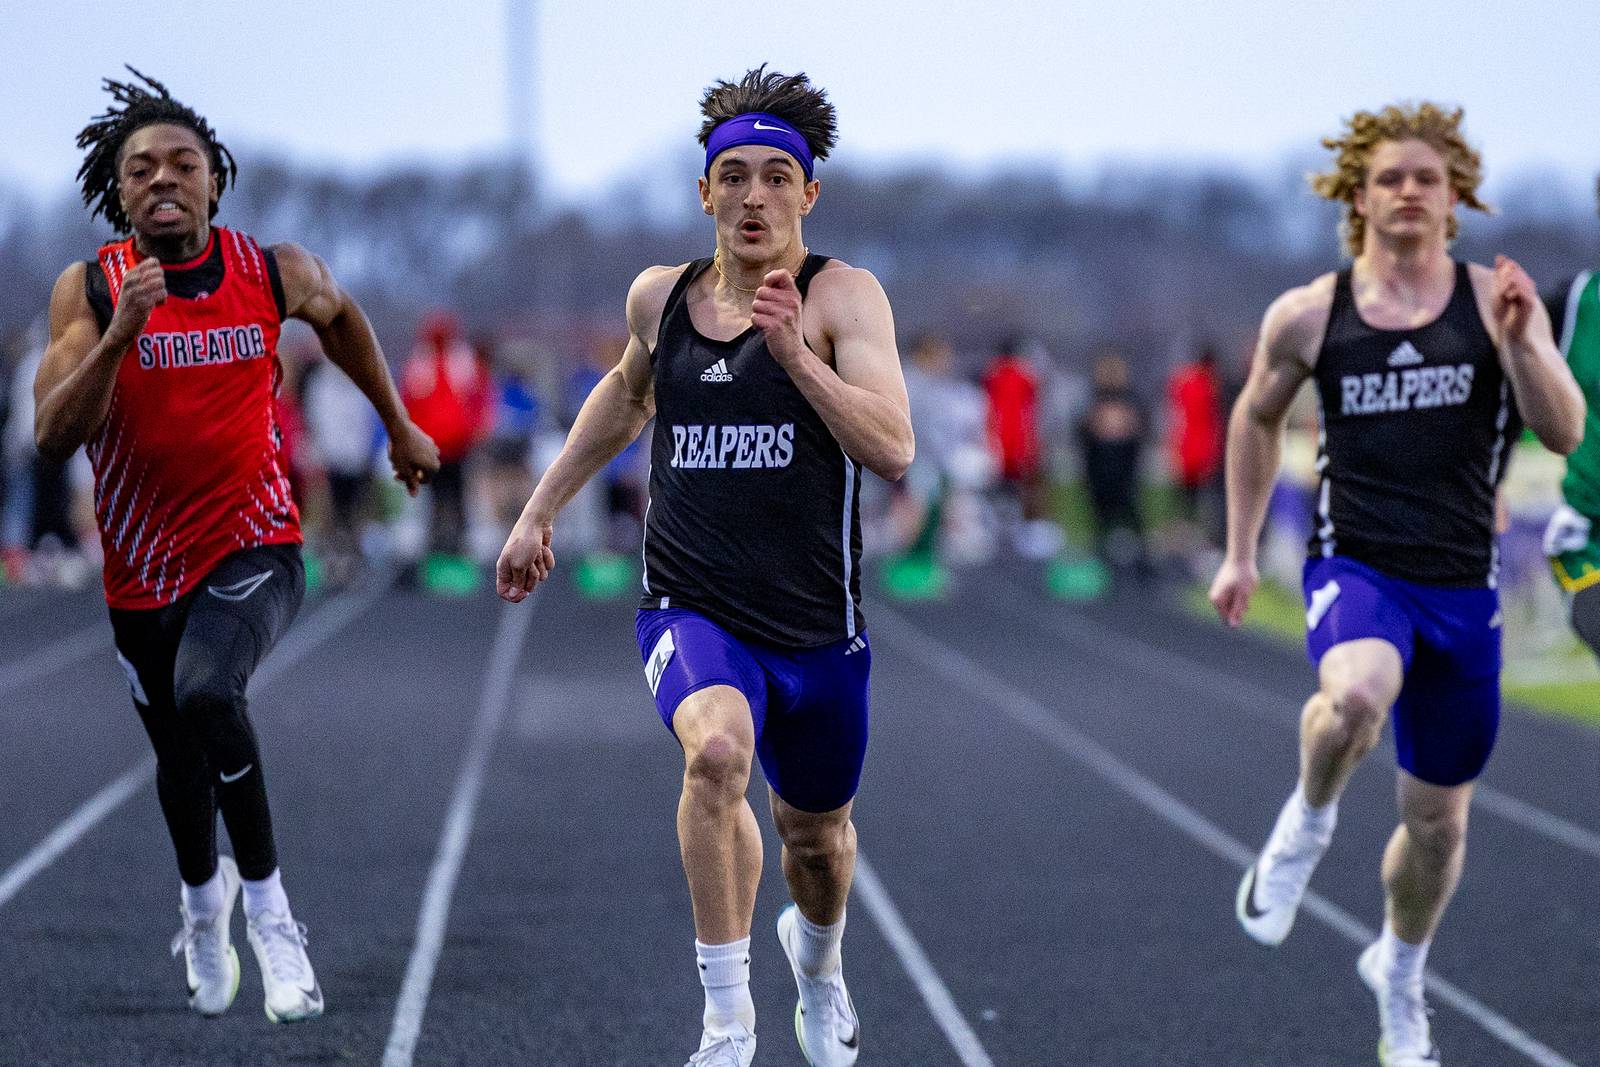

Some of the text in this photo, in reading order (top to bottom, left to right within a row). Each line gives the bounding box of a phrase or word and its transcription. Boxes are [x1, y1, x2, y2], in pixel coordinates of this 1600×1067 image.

[137, 323, 266, 370] STREATOR
[700, 372, 733, 382] adidas
[1341, 363, 1475, 416] REAPERS
[670, 423, 795, 469] REAPERS
